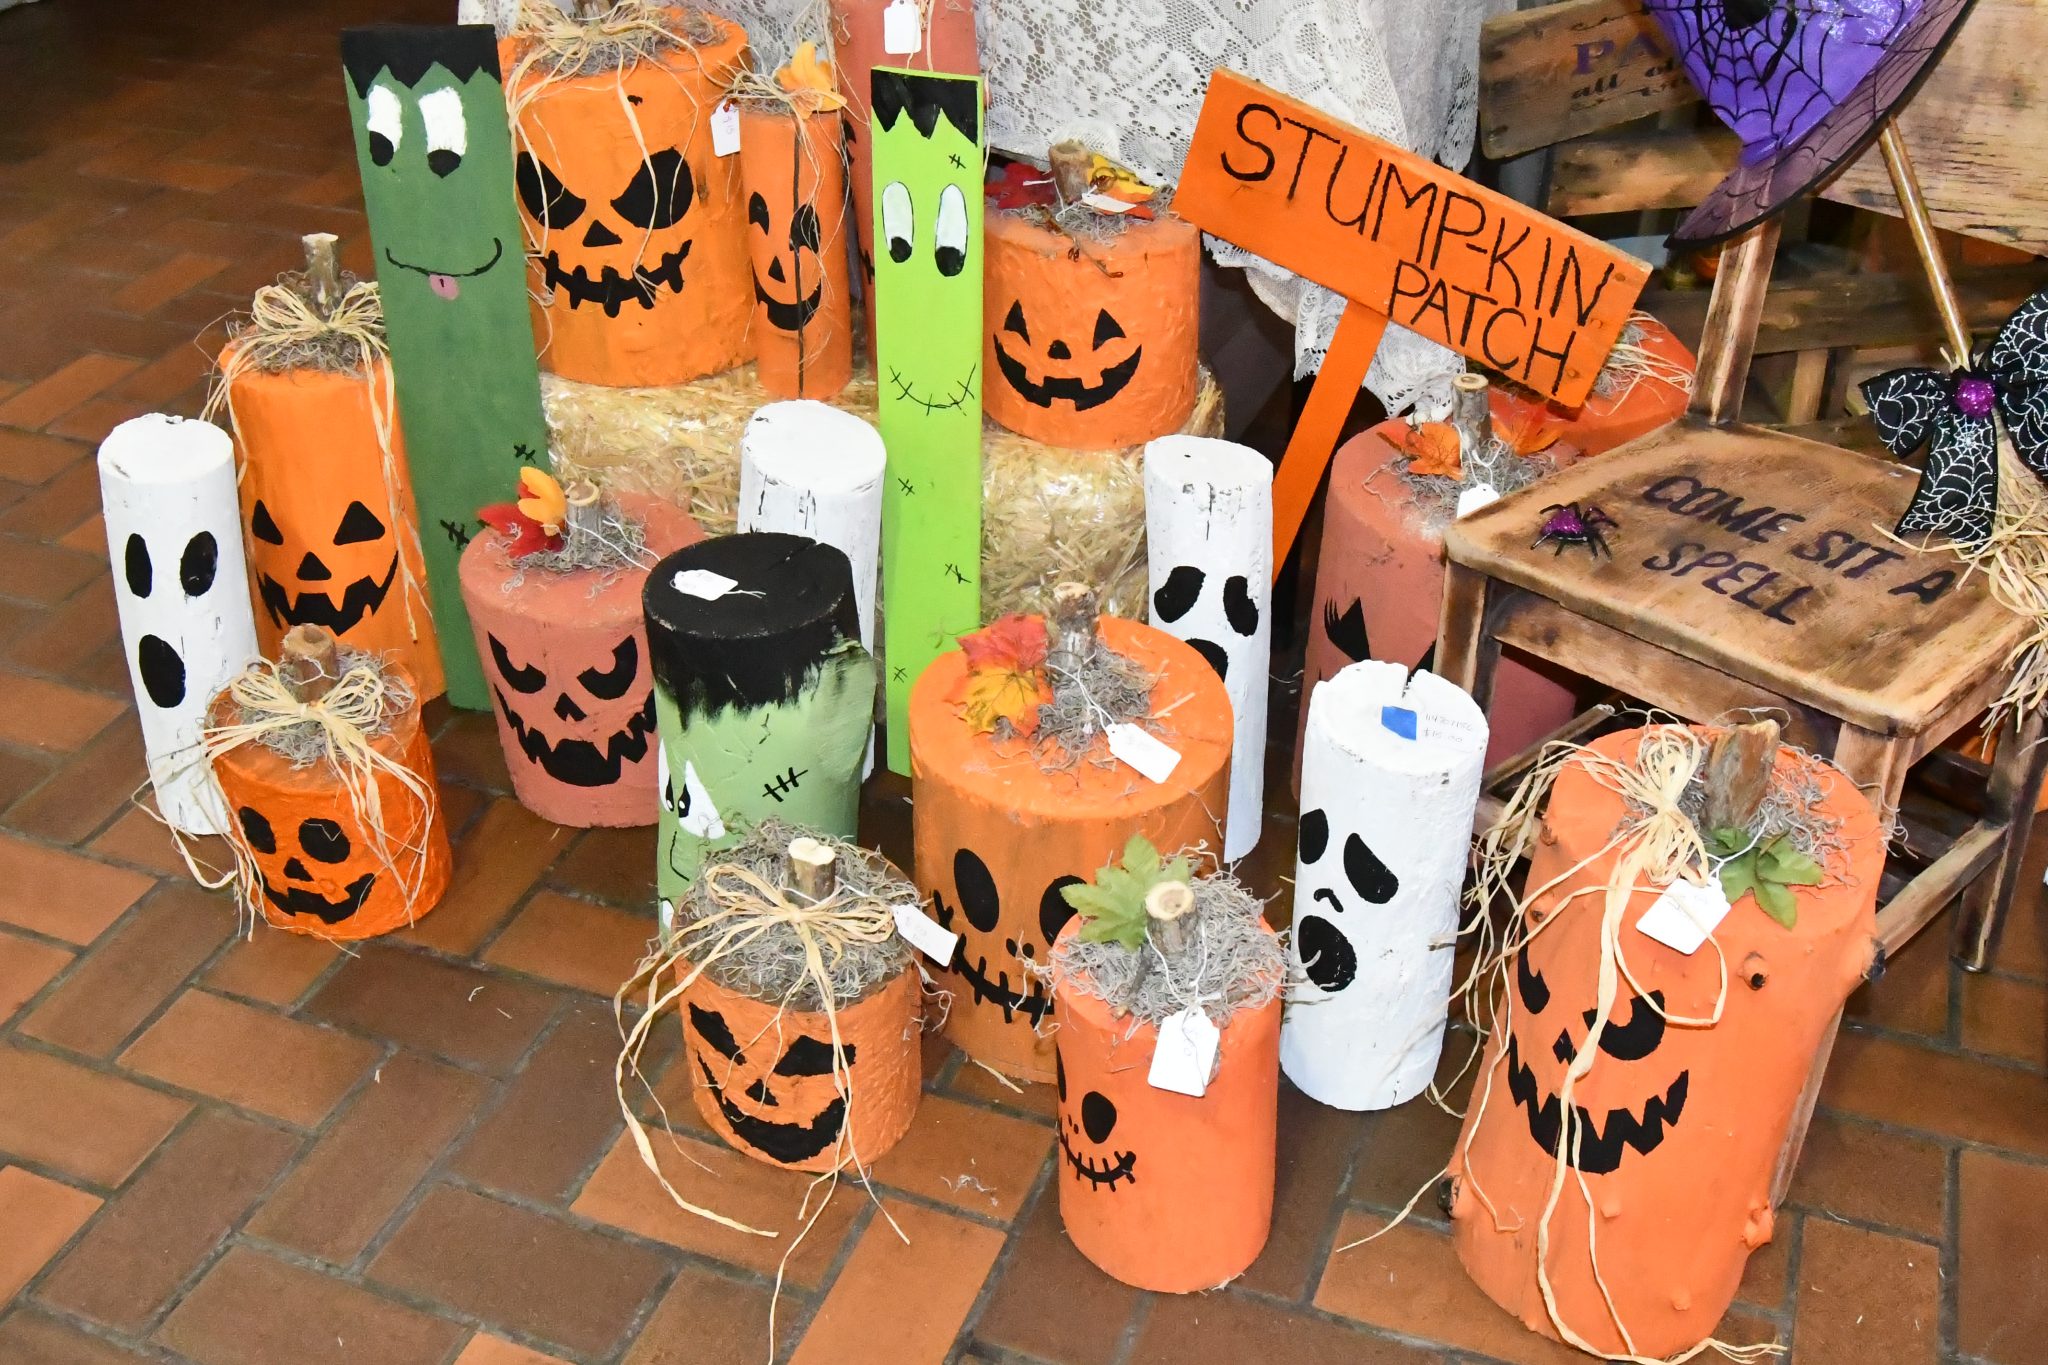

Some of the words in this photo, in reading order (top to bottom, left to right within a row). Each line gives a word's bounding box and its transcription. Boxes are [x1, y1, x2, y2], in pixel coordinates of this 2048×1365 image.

[1220, 103, 1615, 328] STUMP-KIN
[1388, 259, 1576, 395] PATCH
[1641, 475, 1806, 544] COME
[1791, 530, 1906, 579] SIT
[1887, 570, 1957, 605] A
[1641, 542, 1814, 626] SPELL
